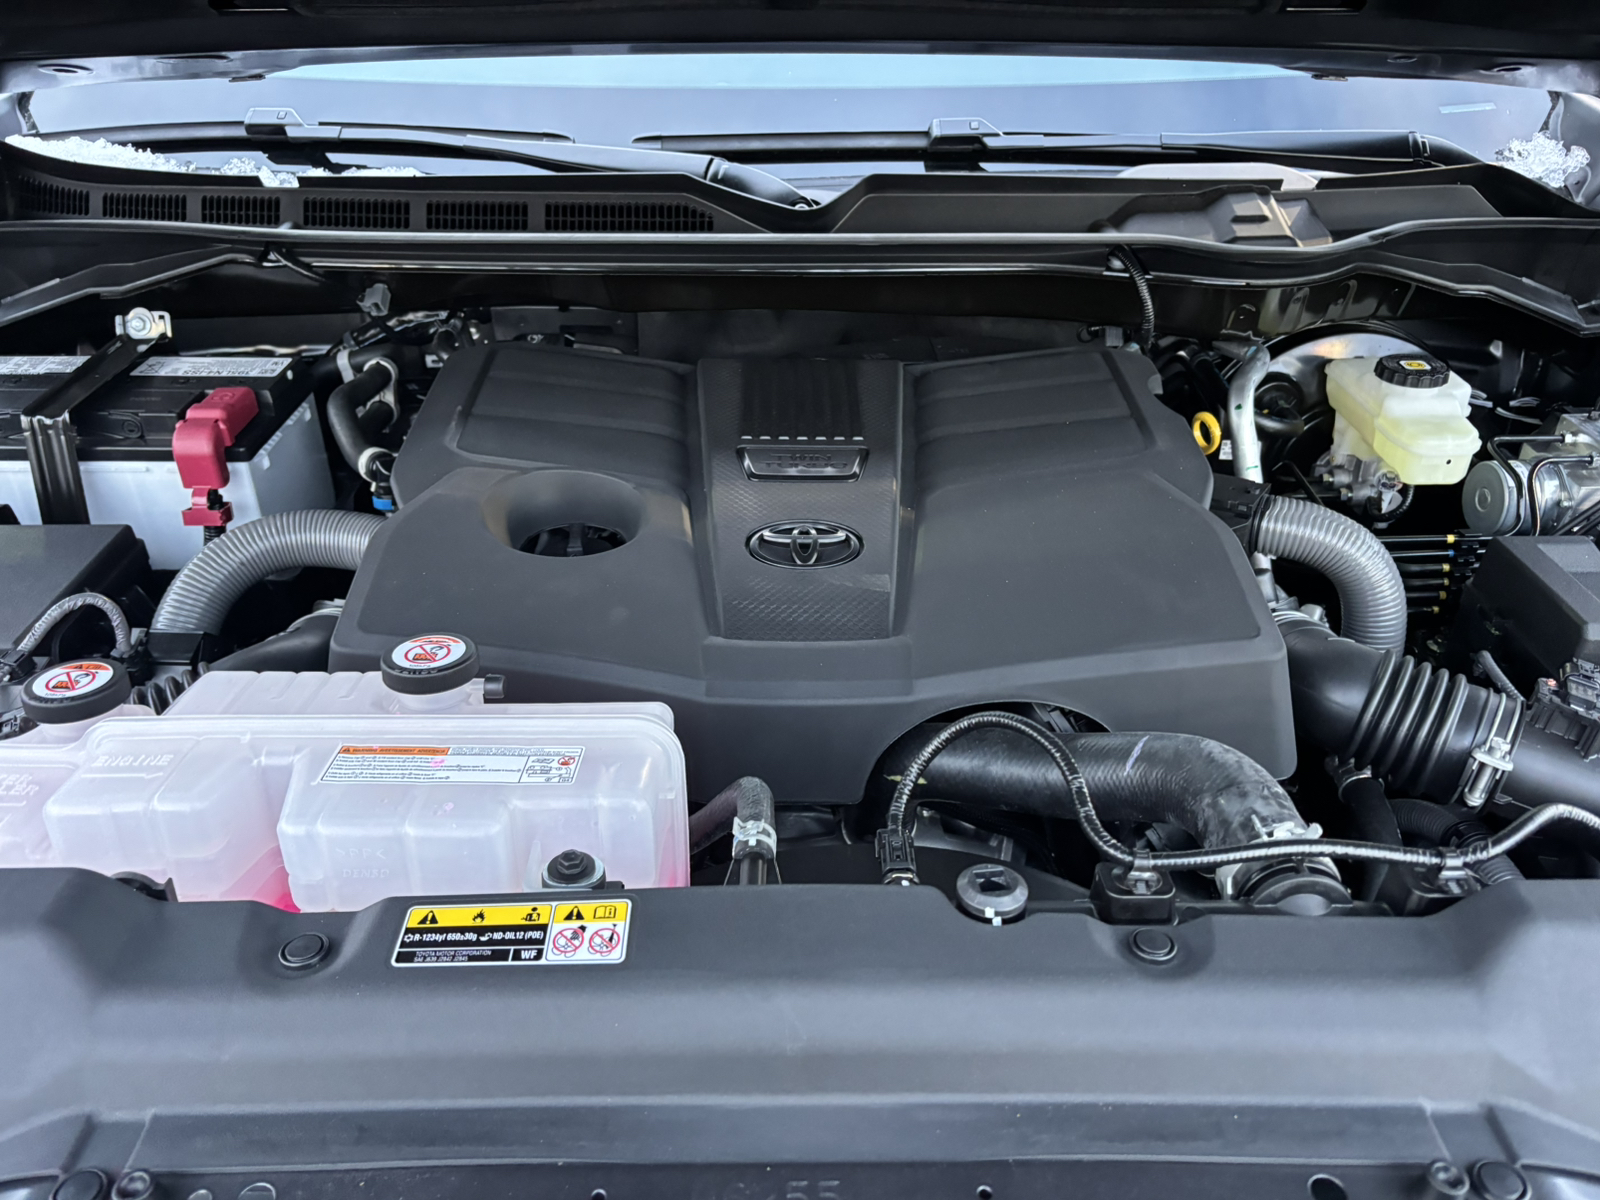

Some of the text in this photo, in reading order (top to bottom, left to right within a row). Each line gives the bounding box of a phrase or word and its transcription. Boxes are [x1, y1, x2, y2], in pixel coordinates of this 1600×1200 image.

[770, 453, 832, 461] TWIN
[90, 754, 174, 767] ENGINE
[342, 868, 390, 878] DENSO
[413, 932, 478, 943] R-1234yf 650±30g
[525, 931, 544, 940] (POE)
[520, 950, 538, 959] WF
